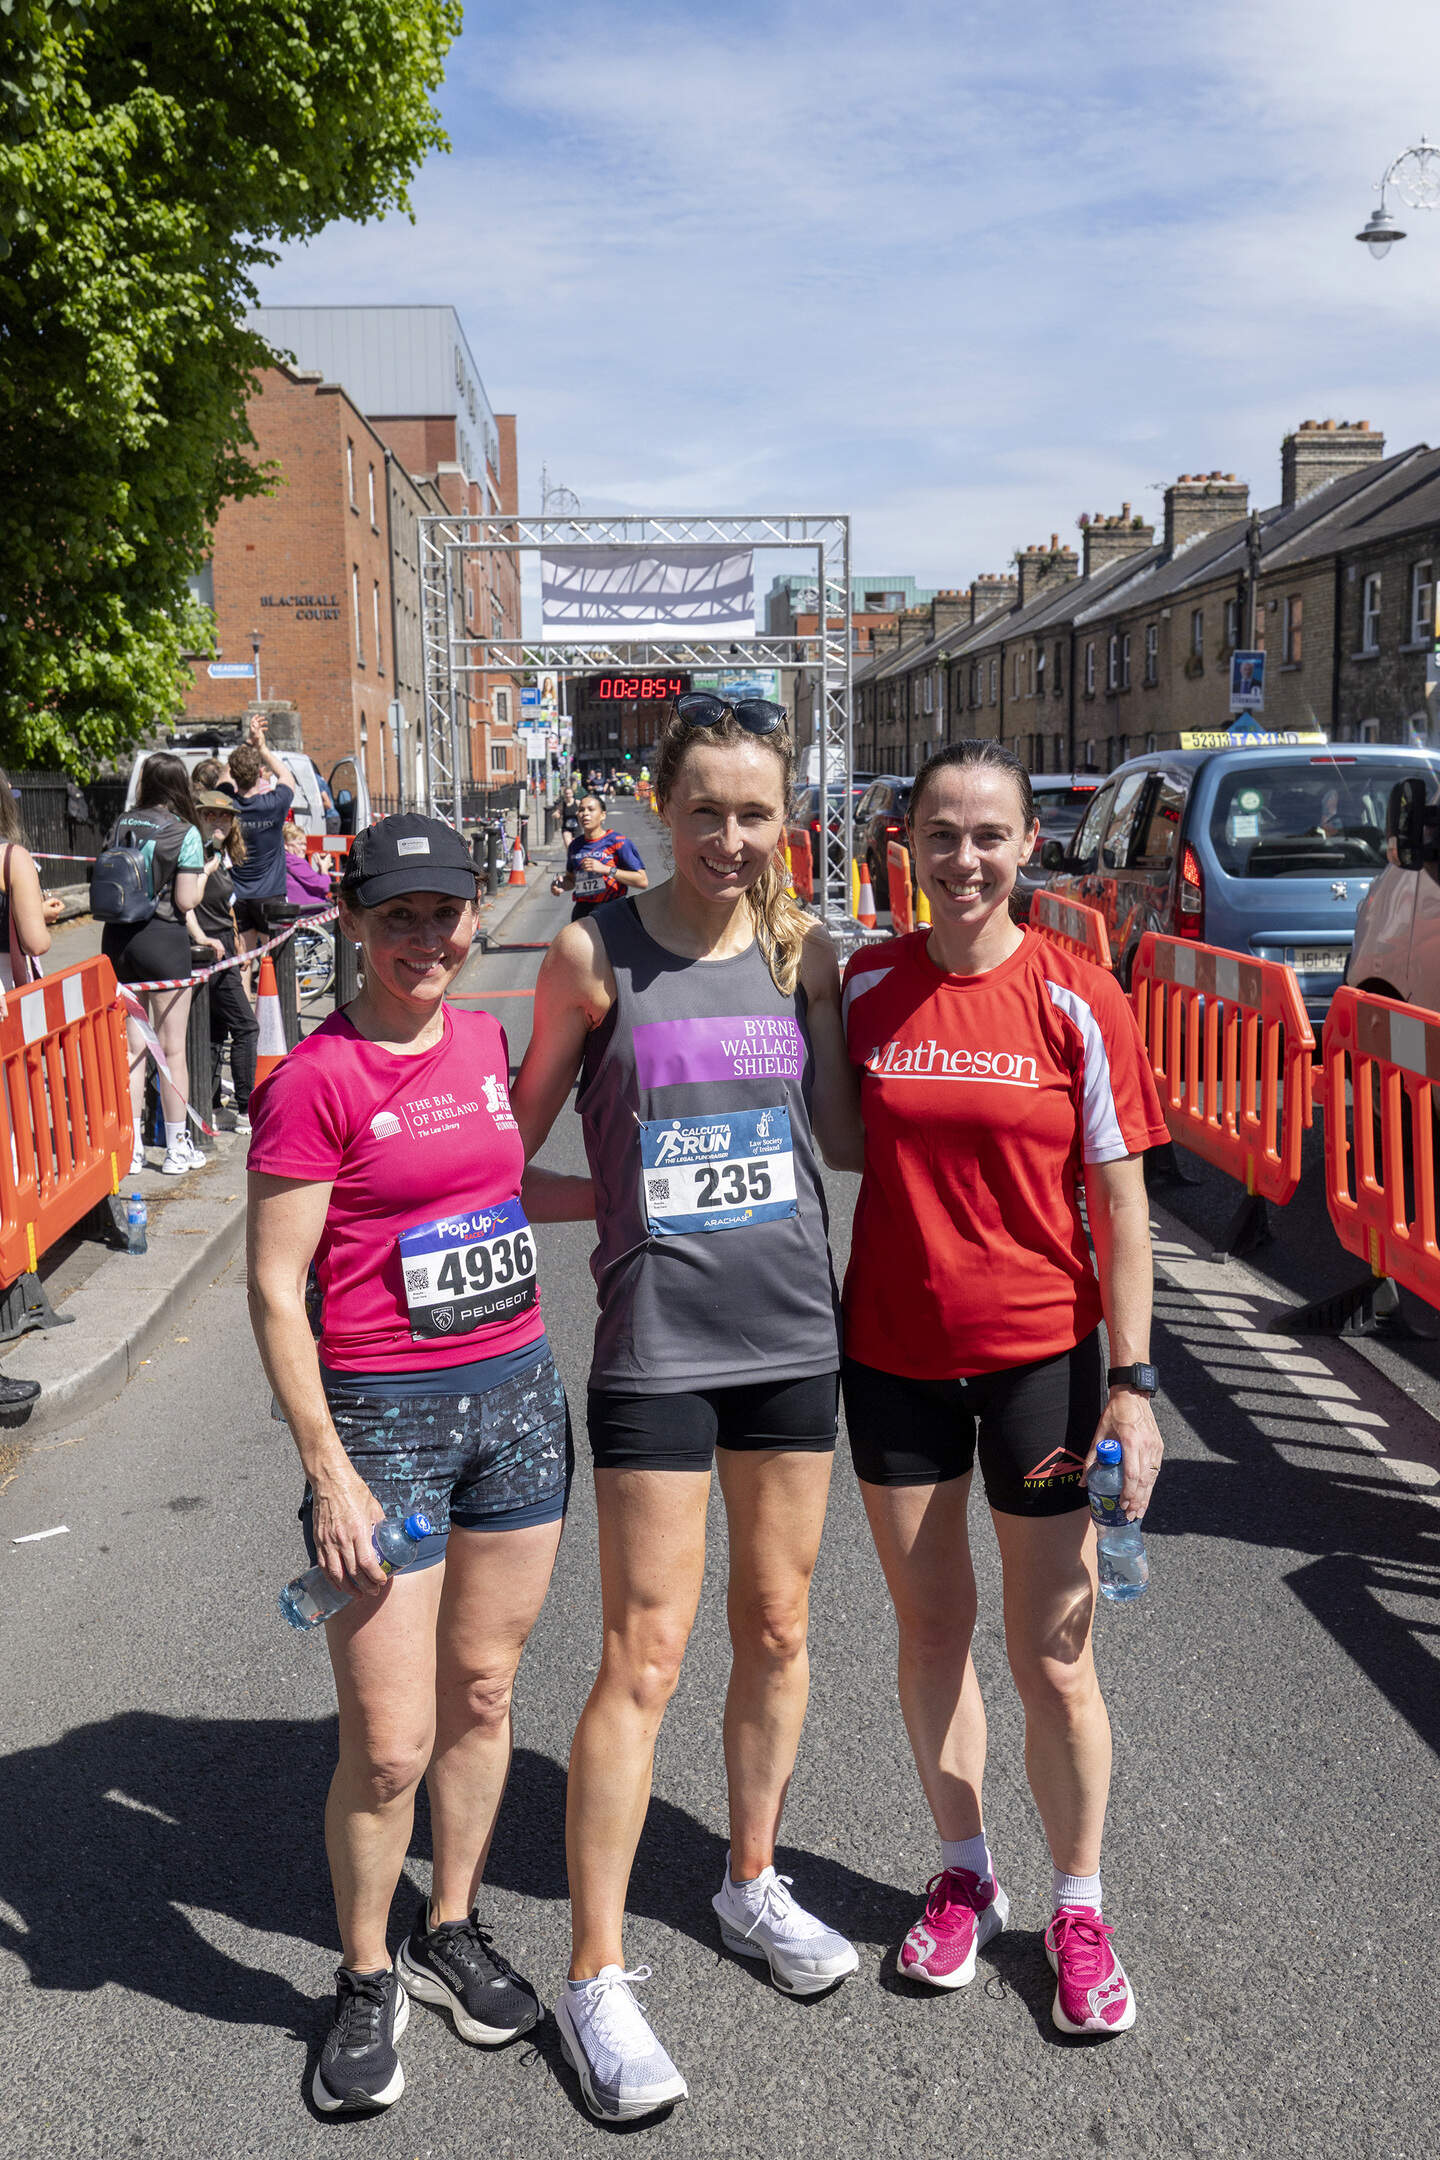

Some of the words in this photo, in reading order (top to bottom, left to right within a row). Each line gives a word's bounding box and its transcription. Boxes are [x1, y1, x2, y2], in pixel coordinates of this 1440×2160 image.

[260, 594, 339, 607] BLACKHALL
[295, 608, 340, 620] COURT
[600, 679, 681, 699] 00:28:54
[1192, 733, 1230, 748] 52313
[1232, 732, 1276, 746] TAXI
[743, 1020, 797, 1038] BYRNE
[720, 1039, 798, 1057] WALLACE
[733, 1057, 798, 1076] SHIELDS
[863, 1039, 1040, 1082] Matheson
[406, 1098, 433, 1113] THE
[432, 1093, 456, 1108] BAR
[412, 1114, 430, 1127] OF
[431, 1102, 479, 1122] IRELAND
[417, 1129, 430, 1138] The
[430, 1126, 442, 1135] Law
[442, 1122, 460, 1133] Library
[681, 1124, 731, 1137] CALCUTTA
[681, 1132, 732, 1155] RUN
[763, 1137, 783, 1147] Society
[694, 1161, 772, 1208] 235
[436, 1221, 470, 1239] Pop
[472, 1213, 492, 1232] Up
[703, 1215, 748, 1227] ARACHAS
[464, 1230, 485, 1241] RACES
[437, 1231, 534, 1297] 4936
[460, 1290, 528, 1321] PEUGEOT
[1024, 1479, 1055, 1488] NIKE
[1060, 1473, 1083, 1485] TRA
